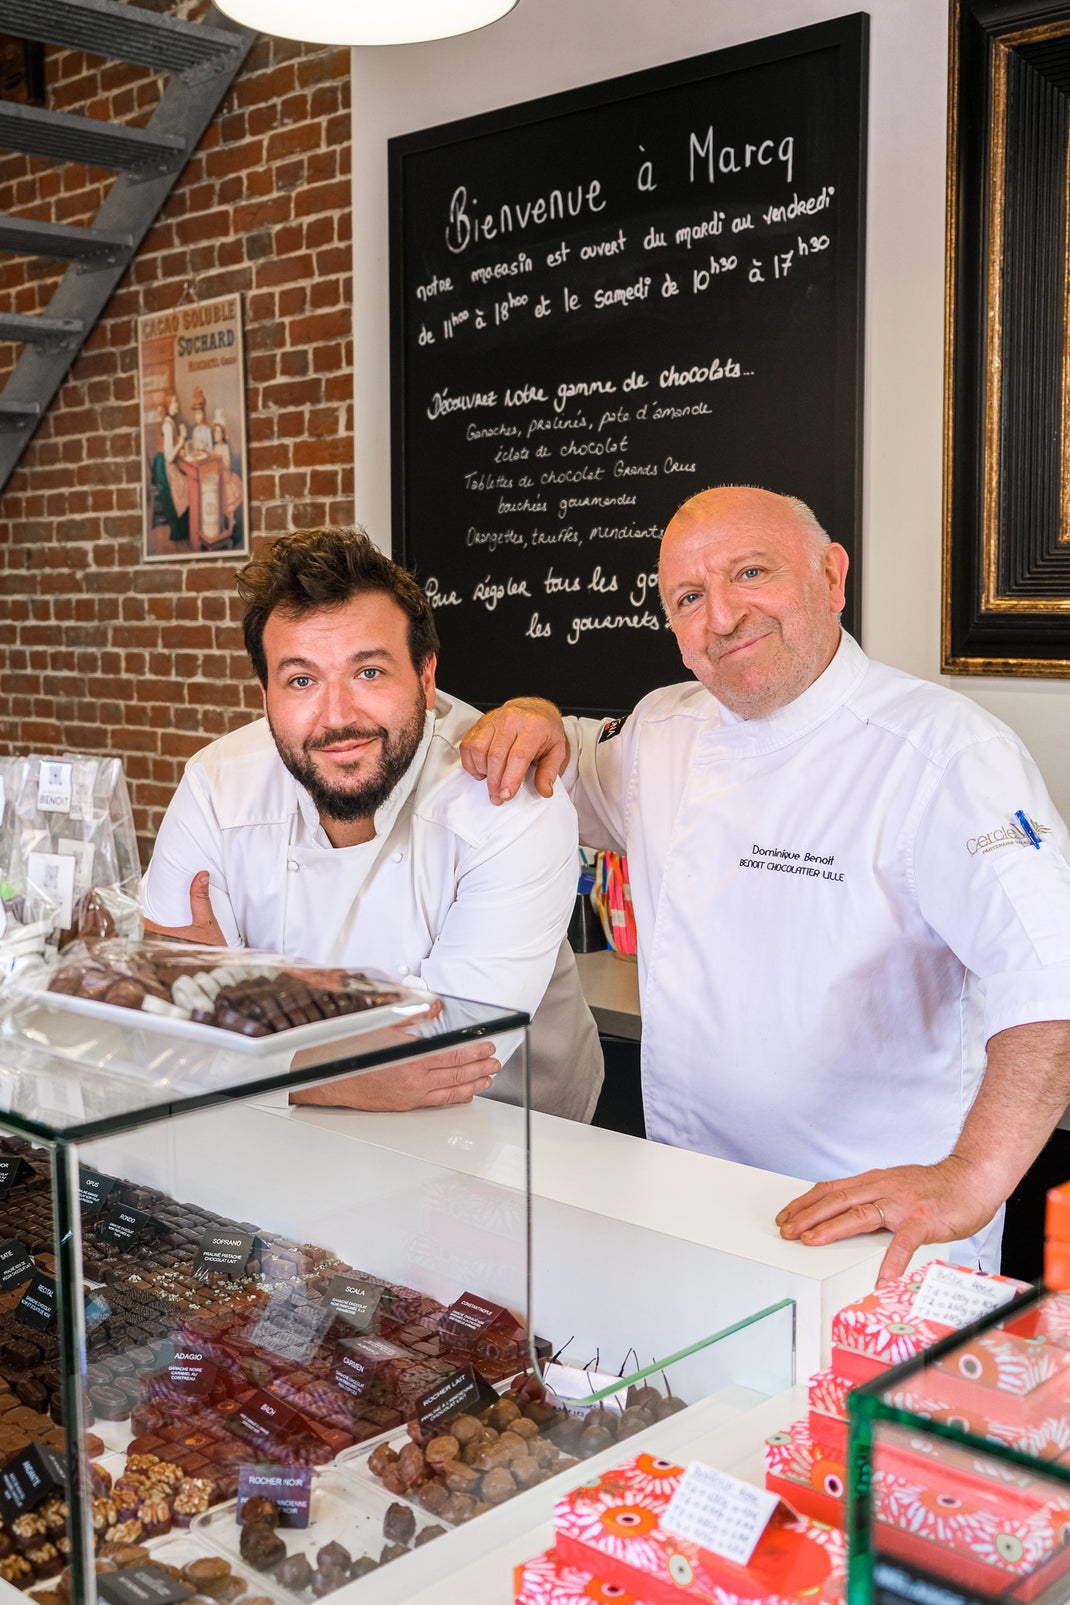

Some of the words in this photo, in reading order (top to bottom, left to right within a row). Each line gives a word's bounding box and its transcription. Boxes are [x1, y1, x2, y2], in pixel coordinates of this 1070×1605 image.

[445, 180, 607, 254] Bienvenue
[637, 145, 657, 191] à
[689, 125, 794, 183] Marcq
[416, 275, 454, 302] notre
[471, 252, 533, 284] magasin
[546, 241, 571, 268] est
[580, 228, 627, 260] ouvert
[643, 227, 668, 250] du
[675, 210, 726, 249] mardi
[731, 213, 755, 233] au
[762, 186, 835, 225] vendredi
[418, 323, 436, 346] de
[475, 309, 487, 330] à
[495, 292, 529, 326] 18h00
[534, 295, 551, 318] et
[563, 287, 582, 312] le
[594, 276, 651, 309] samedi
[661, 272, 680, 297] de
[693, 255, 738, 293] 10h30
[748, 258, 765, 283] à
[774, 235, 830, 278] 17h30
[182, 300, 236, 331] SOLUBLE
[177, 329, 235, 357] SUCHARD
[427, 387, 498, 420] Découvrez
[504, 384, 549, 407] notre
[553, 380, 617, 413] gamme
[622, 371, 649, 393] de
[466, 423, 521, 441] Ganaches,
[636, 401, 713, 420] d'amande
[535, 445, 552, 458] de
[560, 435, 628, 457] chocolat
[464, 471, 513, 491] Tablettes
[518, 475, 535, 488] de
[540, 466, 605, 484] chocolat
[613, 460, 658, 478] Grands
[663, 456, 696, 474] Crus
[498, 493, 547, 514] bouchées
[558, 494, 636, 519] gourmandes
[466, 527, 528, 551] Orangettes,
[425, 577, 463, 608] Pour
[545, 566, 581, 593] tous
[587, 566, 618, 593] les
[525, 612, 551, 639] les
[40, 795, 68, 806] BENOIT
[966, 825, 1018, 855] Cercle
[752, 844, 801, 860] Dominique
[804, 852, 835, 866] Benoit
[739, 858, 765, 870] BENOIT
[766, 862, 821, 878] CHOCOLATIER
[822, 870, 845, 882] LILLE
[86, 1179, 99, 1188] OPUS
[119, 1213, 136, 1223] RONDO
[212, 1238, 242, 1247] SOPRANO
[345, 1286, 365, 1296] SCALA
[174, 1352, 202, 1361] ADAGIO
[343, 1356, 364, 1372] CARMEN
[423, 1384, 451, 1406] ROCHER
[451, 1374, 465, 1387] LAIT
[260, 1403, 276, 1416] BACH
[249, 1475, 282, 1486] ROCHER
[283, 1478, 303, 1487] NOIR
